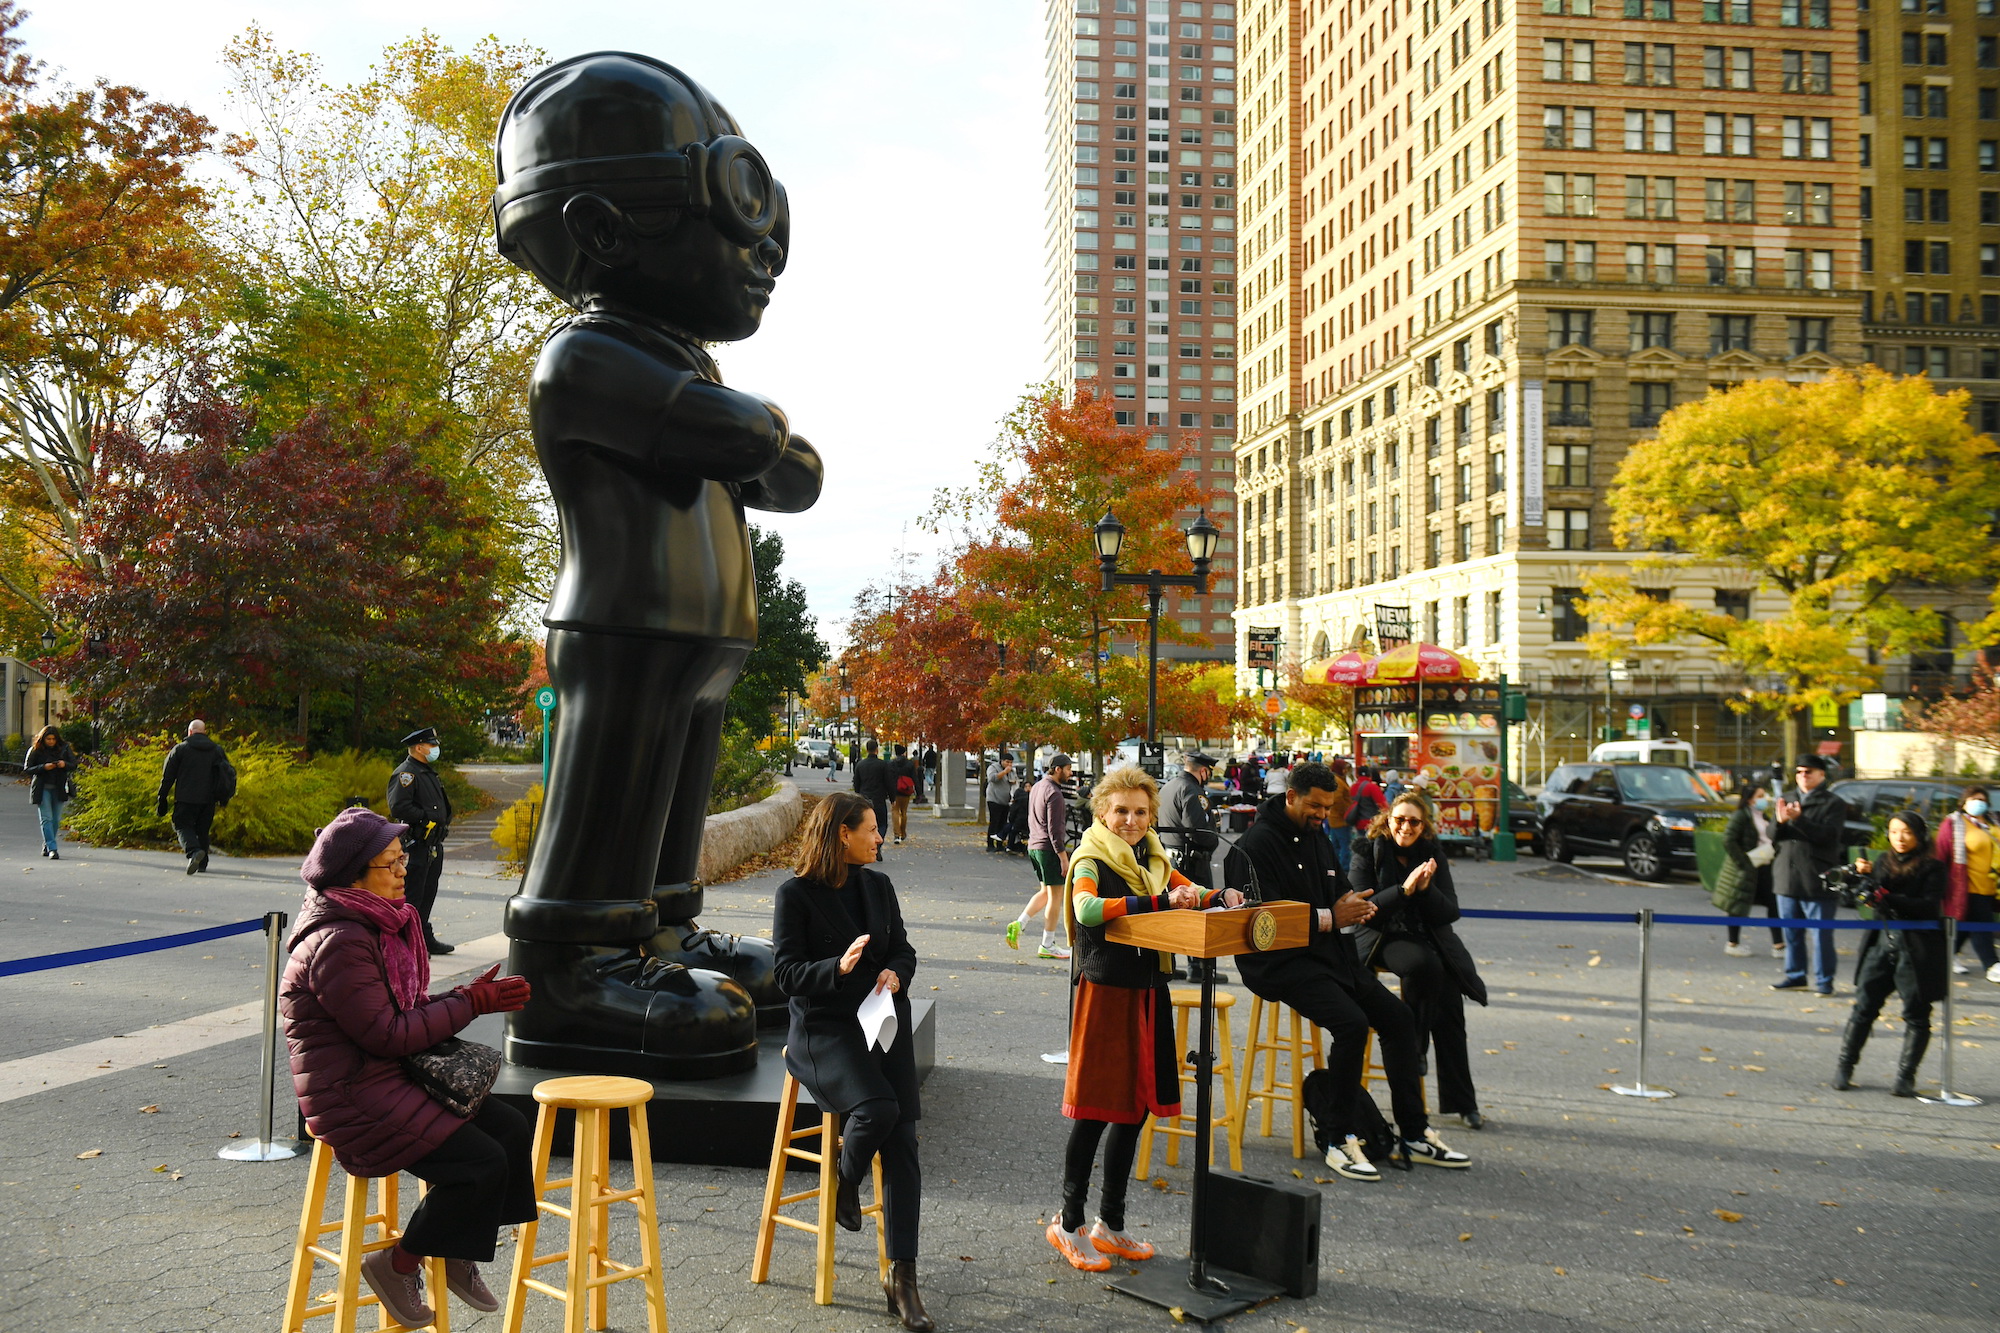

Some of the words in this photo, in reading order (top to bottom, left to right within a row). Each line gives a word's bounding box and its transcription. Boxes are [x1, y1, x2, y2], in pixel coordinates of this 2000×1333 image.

[1376, 606, 1409, 623] NEW
[1250, 627, 1277, 635] SCHOOL
[1378, 622, 1409, 638] YORK
[1249, 640, 1275, 652] FILM
